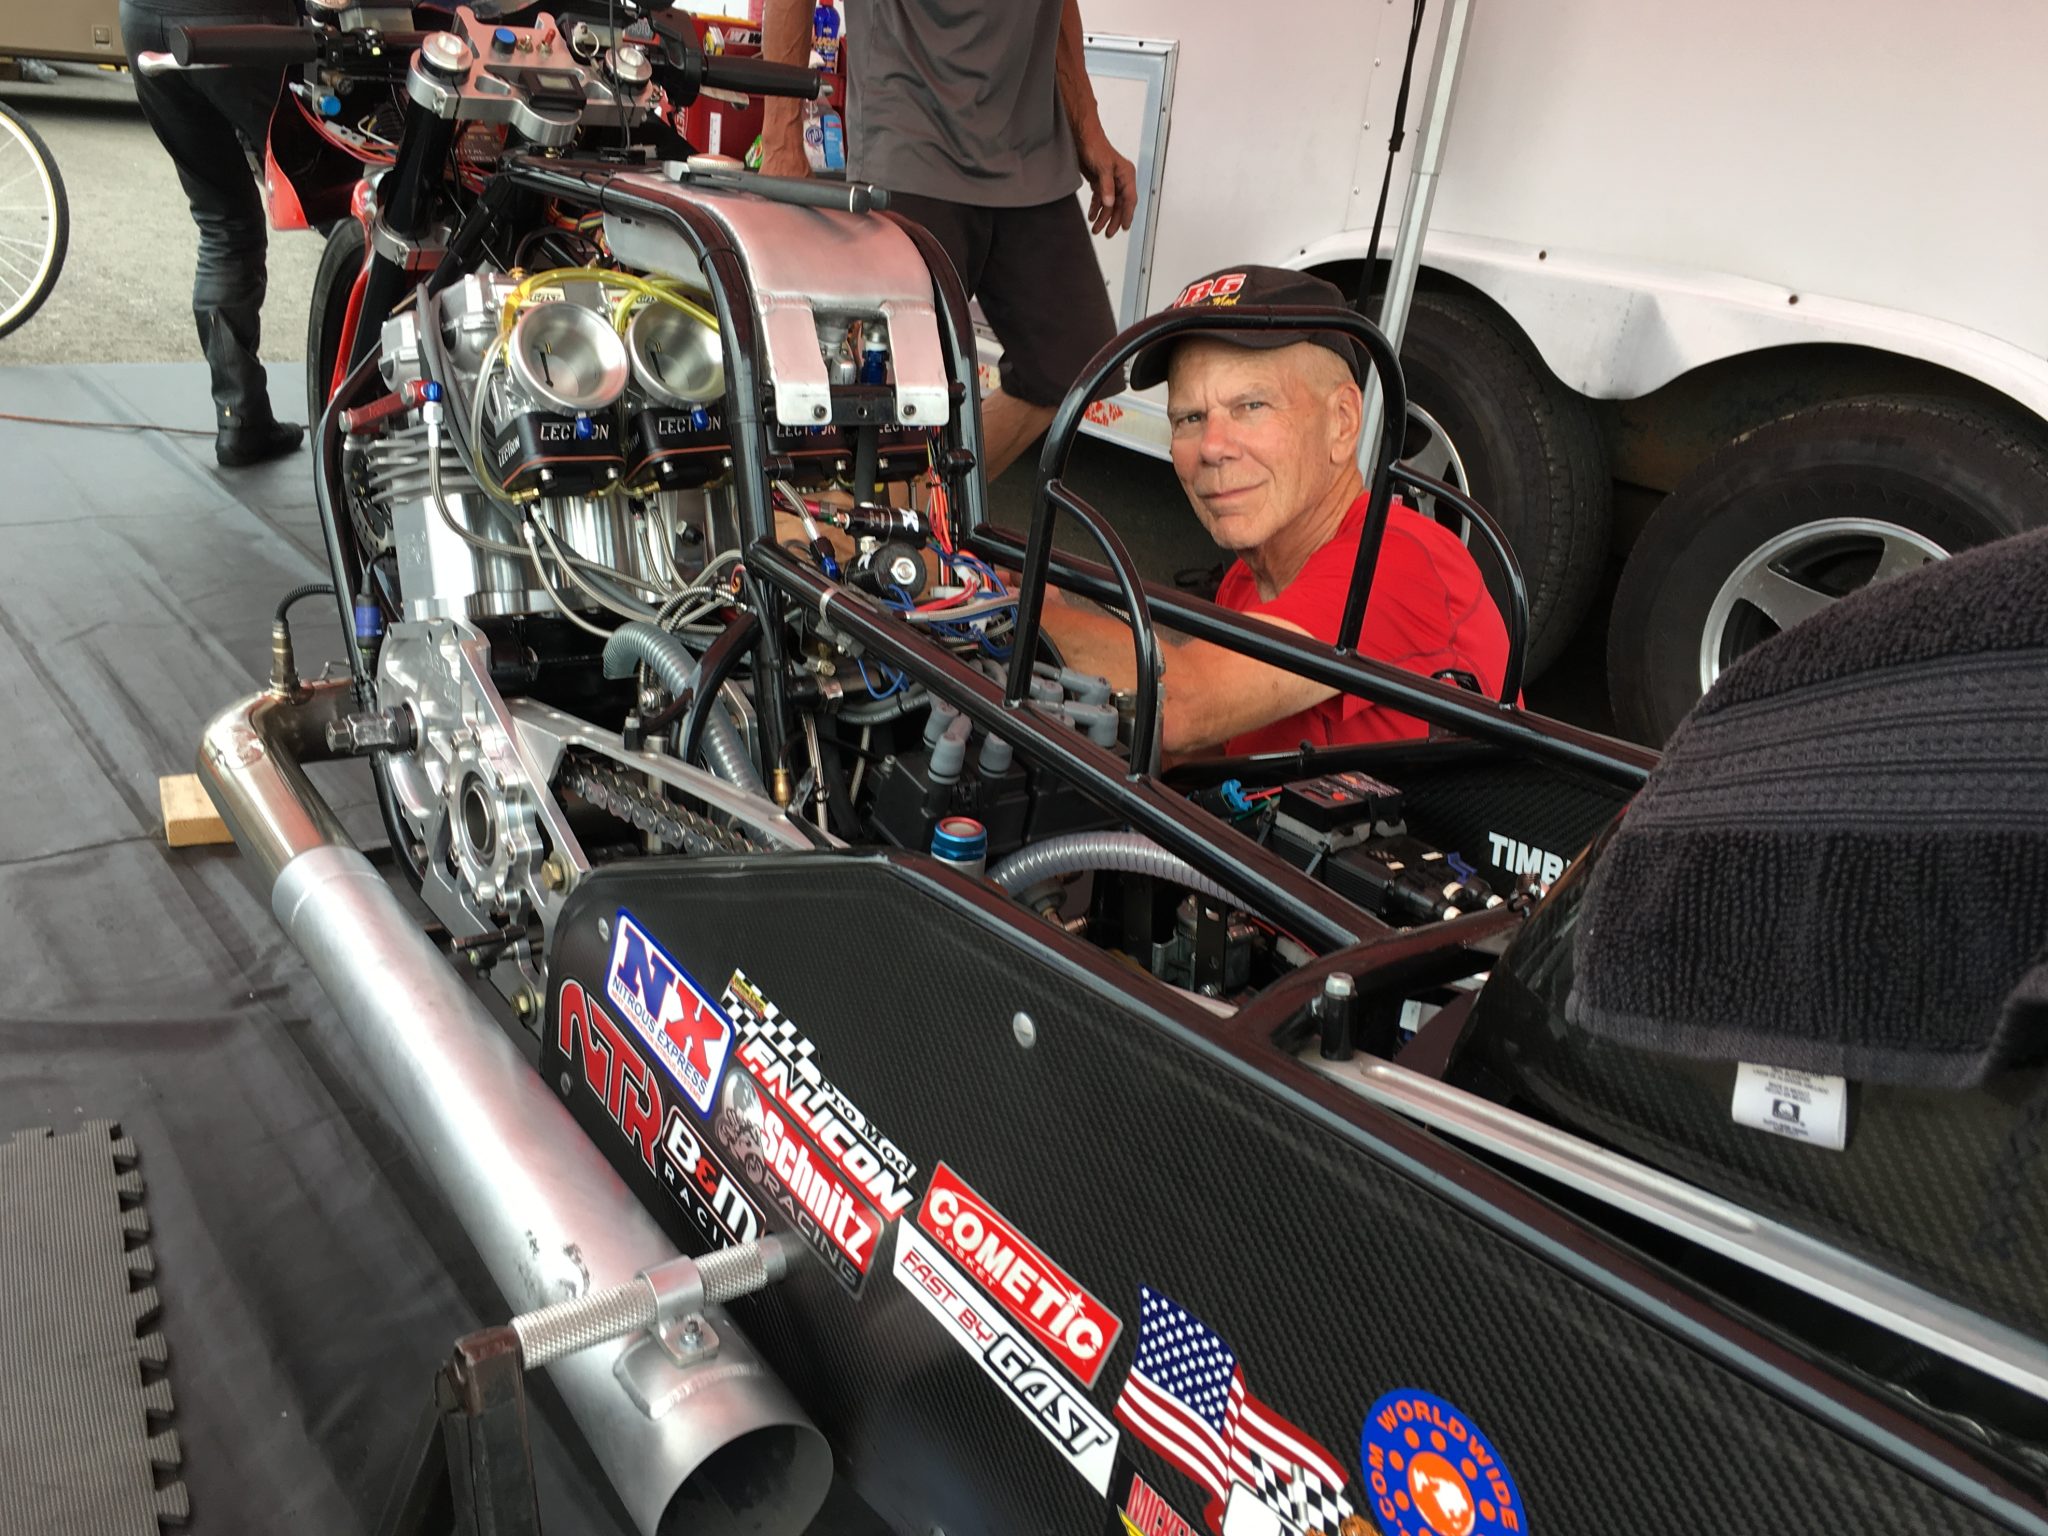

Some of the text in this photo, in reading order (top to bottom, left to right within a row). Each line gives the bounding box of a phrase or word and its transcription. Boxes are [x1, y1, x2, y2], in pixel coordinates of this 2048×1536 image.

[540, 423, 610, 441] LECTON
[658, 416, 721, 435] LECTN
[1488, 831, 1571, 885] TIMB
[612, 974, 707, 1096] NITROUS EXPRESS
[616, 922, 724, 1082] NX
[623, 1003, 653, 1044] GENERATION
[654, 1041, 676, 1072] NITROUS
[676, 1068, 701, 1102] SYSTEMS
[743, 1038, 914, 1214] FALICON
[819, 1076, 915, 1178] Pro Mod
[665, 1161, 731, 1250] RACI
[761, 1109, 873, 1265] Schnitz
[763, 1169, 859, 1287] RACING
[929, 1187, 1104, 1360] COMETIC
[935, 1226, 998, 1288] GASKET
[902, 1249, 1113, 1456] FAST BY GAST
[1125, 1472, 1201, 1536] MICK
[1376, 1399, 1520, 1534] WORLDWIDE
